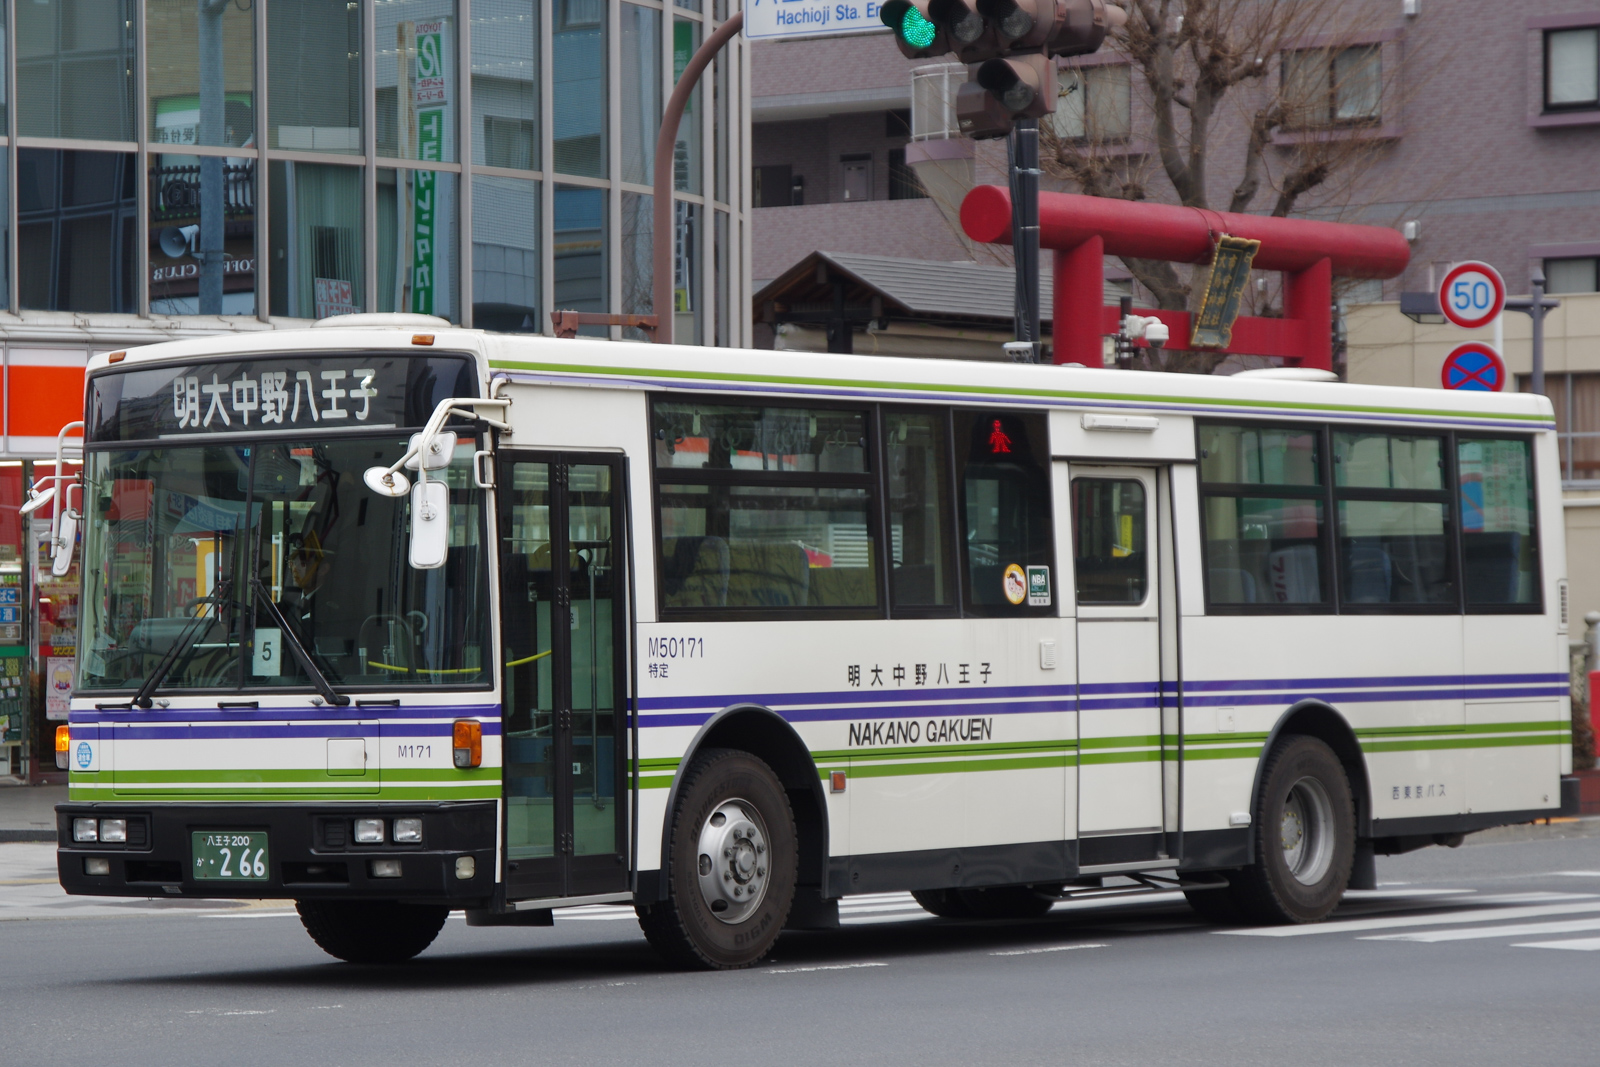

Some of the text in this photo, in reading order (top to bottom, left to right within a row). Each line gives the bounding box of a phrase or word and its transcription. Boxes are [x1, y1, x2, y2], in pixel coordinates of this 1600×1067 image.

[777, 7, 830, 25] Hachioji
[836, 4, 861, 21] Sta.
[1454, 281, 1490, 310] 50
[173, 368, 378, 429] 明大中野八王子
[0, 608, 13, 621] 酒
[262, 641, 272, 661] 5
[648, 637, 703, 658] M50171
[648, 662, 669, 678] 特定
[848, 662, 992, 687] 明大中野八王子
[848, 717, 993, 746] NAKANO GAKUEN
[398, 745, 431, 758] M171
